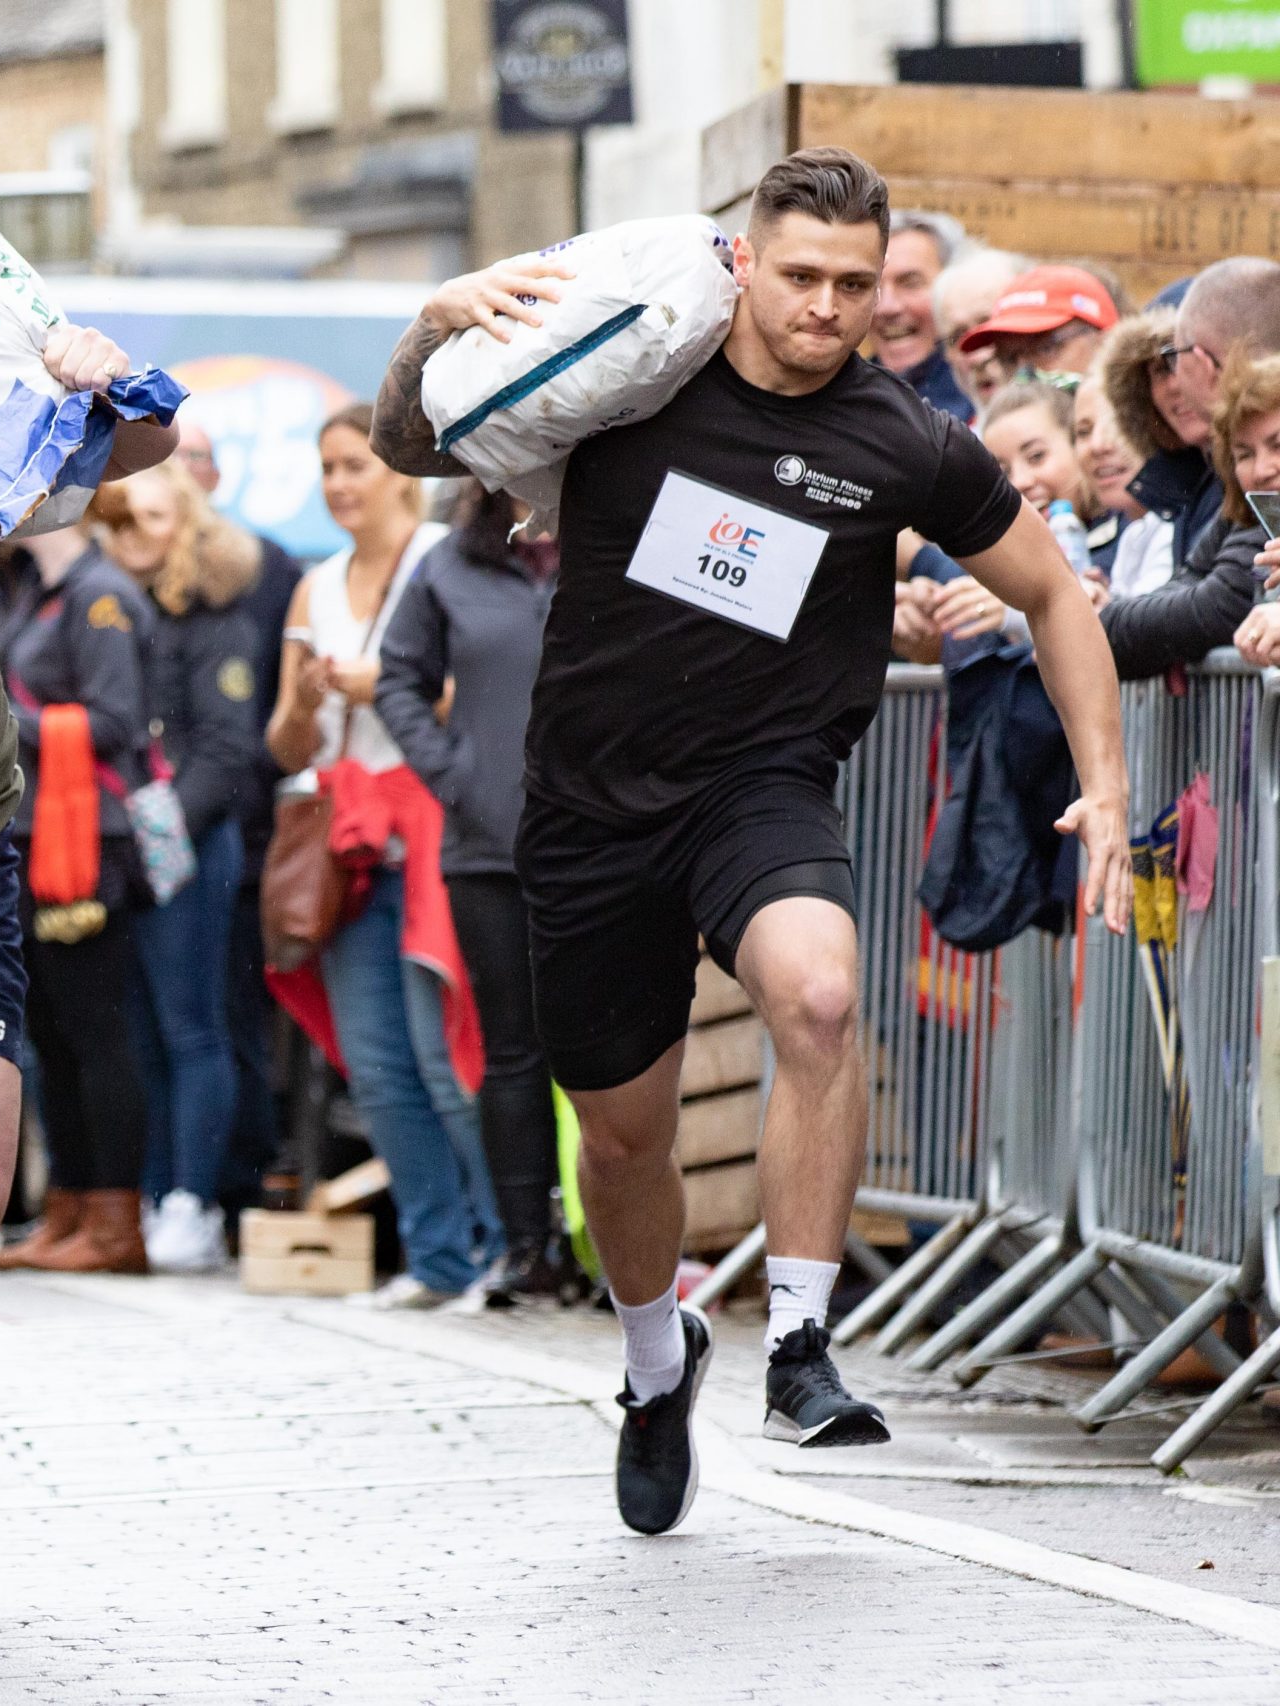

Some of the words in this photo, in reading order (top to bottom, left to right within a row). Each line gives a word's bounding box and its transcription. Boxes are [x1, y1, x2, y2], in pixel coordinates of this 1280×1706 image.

[805, 469, 839, 487] Atrium
[840, 479, 874, 497] Fitness
[697, 554, 747, 588] 109
